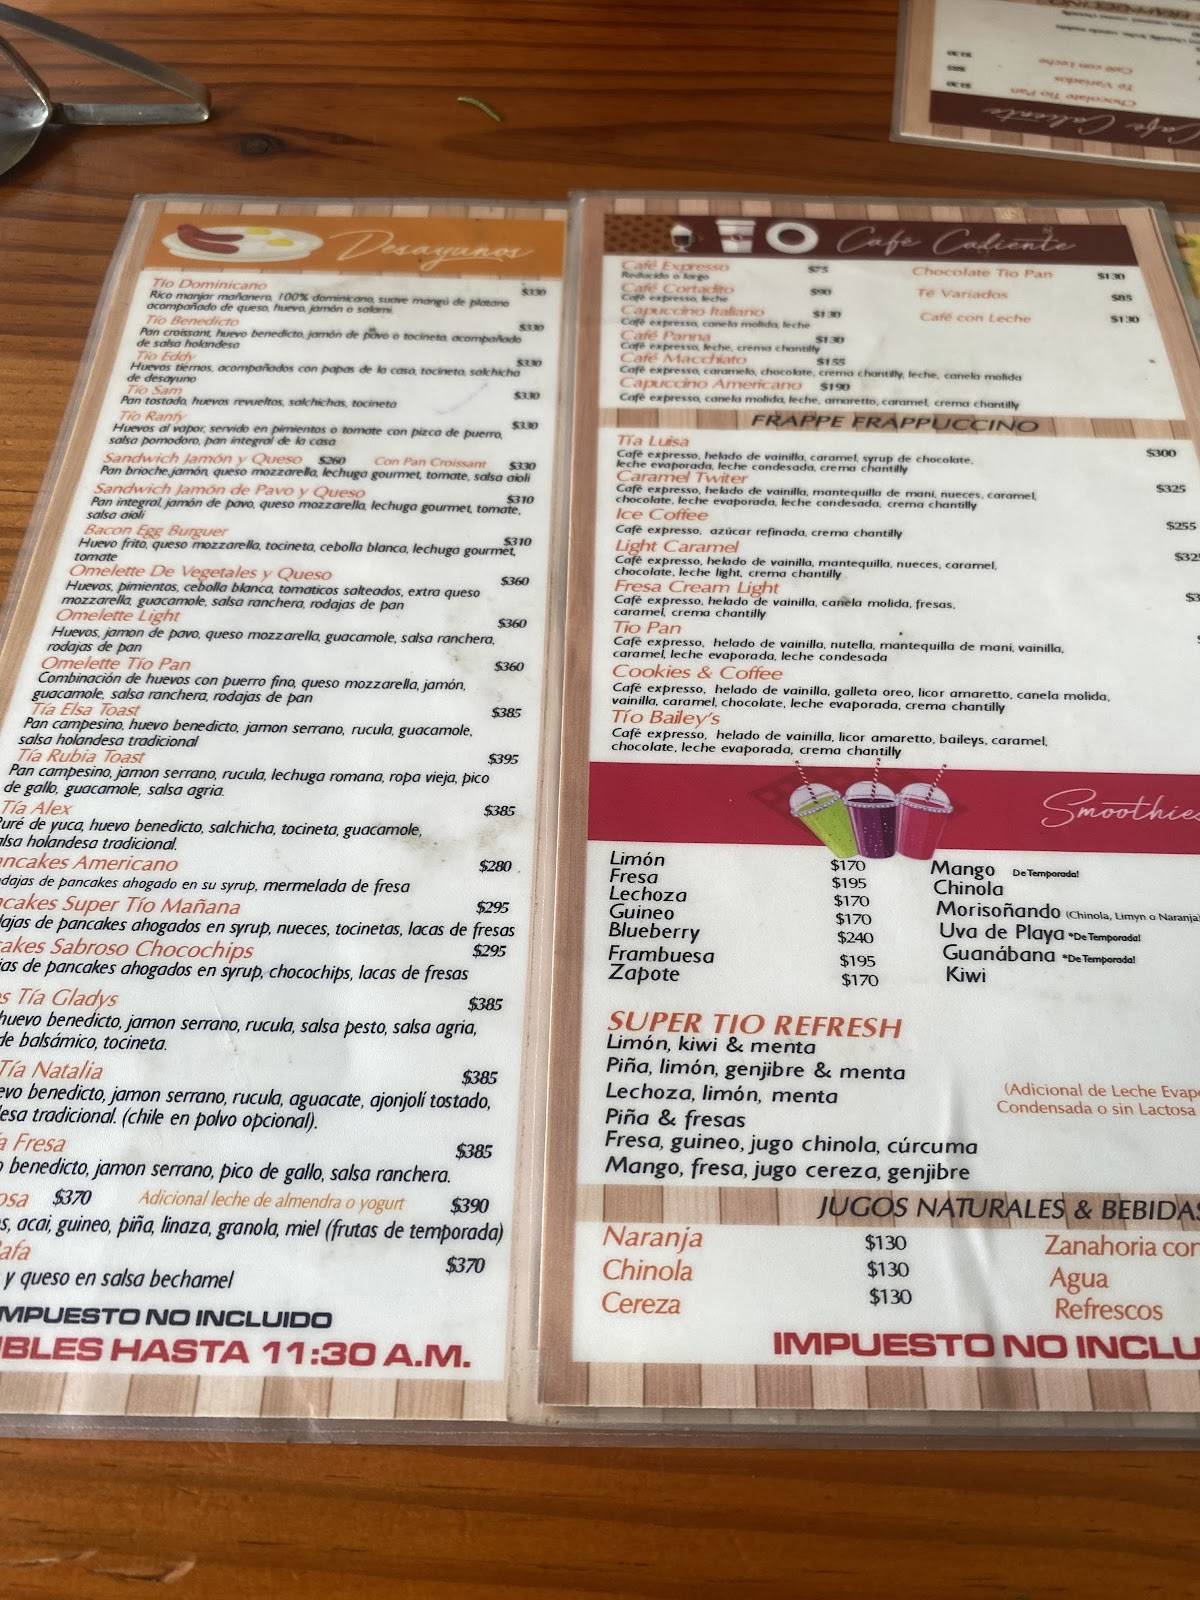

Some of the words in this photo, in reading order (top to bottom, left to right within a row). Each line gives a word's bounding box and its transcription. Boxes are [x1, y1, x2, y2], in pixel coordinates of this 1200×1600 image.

[327, 229, 535, 271] Desayunos
[620, 377, 708, 391] Capuccino
[751, 412, 844, 430] FRAPPE
[851, 414, 1040, 434] FRAPPUCCINO
[649, 435, 690, 448] Luisa
[252, 453, 303, 466] Queso
[616, 470, 690, 483] Caramel
[696, 471, 748, 484] Twiter
[1156, 484, 1186, 493] $325
[616, 508, 643, 520] Ice
[649, 508, 709, 521] Coffee
[1166, 521, 1196, 530] $255
[69, 564, 145, 577] Omelette
[182, 566, 257, 582] Vegetales
[261, 570, 272, 582] y
[277, 568, 332, 582] Queso
[501, 576, 530, 586] $360
[647, 621, 682, 634] Pan
[42, 656, 120, 670] Omelette
[128, 657, 154, 670] Tío
[158, 658, 191, 671] Pan
[494, 661, 524, 672] $360
[613, 664, 691, 678] Cookies
[697, 666, 712, 679] &
[720, 666, 783, 680] Coffee
[32, 702, 56, 716] Tía
[60, 702, 93, 716] Elsa
[100, 703, 141, 716] Toast
[492, 707, 522, 718] $385
[612, 710, 644, 723] Tío
[650, 710, 720, 729] Bailey's
[612, 728, 642, 740] Café
[716, 730, 760, 740] helado
[765, 730, 781, 740] de
[839, 732, 864, 742] licor
[2, 800, 27, 814] Tía
[30, 800, 72, 815] Alex
[484, 804, 516, 817] $385
[72, 855, 178, 872] Americano
[479, 859, 512, 873] $280
[610, 851, 664, 866] Limón
[831, 859, 866, 872] $170
[931, 860, 995, 880] Mango
[610, 868, 658, 884] Fresa
[832, 877, 866, 889] $195
[934, 880, 1003, 896] Chinola
[62, 896, 120, 916] Super
[127, 896, 156, 913] Tío
[160, 898, 240, 914] Mañana
[476, 900, 510, 915] $295
[610, 886, 686, 902] Lechoza
[834, 894, 869, 907] $170
[610, 903, 674, 920] Guineo
[836, 912, 872, 926] $170
[936, 901, 1060, 918] Morisoñando
[609, 922, 700, 944] Blueberry
[838, 931, 874, 944] $240
[940, 922, 977, 938] Uva
[985, 924, 1008, 939] de
[1016, 924, 1064, 944] Playa
[50, 938, 129, 956] Sabroso
[136, 939, 254, 962] Chocochips
[472, 943, 506, 958] $295
[608, 945, 714, 964] Frambuesa
[840, 954, 876, 968] $195
[943, 944, 1055, 962] Guanábana
[608, 964, 680, 985] Zapote
[842, 973, 878, 987] $170
[947, 966, 986, 982] Kiwi
[608, 1011, 702, 1033] SUPER
[714, 1014, 765, 1034] TIO
[774, 1016, 902, 1039] REFRESH
[607, 1034, 670, 1053] Limón,
[679, 1036, 717, 1052] kiwi
[726, 1036, 743, 1052] &
[751, 1042, 816, 1054] menta
[0, 1060, 26, 1078] Tía
[32, 1060, 103, 1080] Natalia
[462, 1069, 498, 1086] $385
[13, 1133, 66, 1152] Fresa
[456, 1142, 493, 1160] $385
[52, 1188, 92, 1206] $370
[138, 1189, 210, 1206] Adicional
[211, 1190, 250, 1207] leche
[254, 1192, 272, 1208] de
[275, 1192, 342, 1209] almendra
[346, 1198, 355, 1209] o
[358, 1198, 405, 1215] yogurt
[450, 1197, 489, 1215] $390
[816, 1195, 908, 1221] JUGOS
[916, 1197, 1066, 1220] NATURALES
[1074, 1200, 1092, 1221] &
[603, 1225, 702, 1254] Naranja
[866, 1234, 906, 1252] $130
[1045, 1234, 1157, 1256] Zanahoria
[446, 1256, 485, 1274] $370
[603, 1258, 692, 1281] Chinola
[868, 1260, 909, 1278] $130
[1050, 1266, 1109, 1294] Agua
[602, 1291, 680, 1314] Cereza
[870, 1288, 912, 1306] $130
[1056, 1297, 1163, 1320] Refrescos
[146, 1309, 190, 1326] NO
[196, 1310, 332, 1328] INCLUIDO
[110, 1338, 250, 1364] HASTA
[262, 1341, 376, 1366] 11:30
[383, 1344, 471, 1368] A.M.
[774, 1332, 996, 1358] IMPUESTO
[1003, 1334, 1068, 1359] NO
